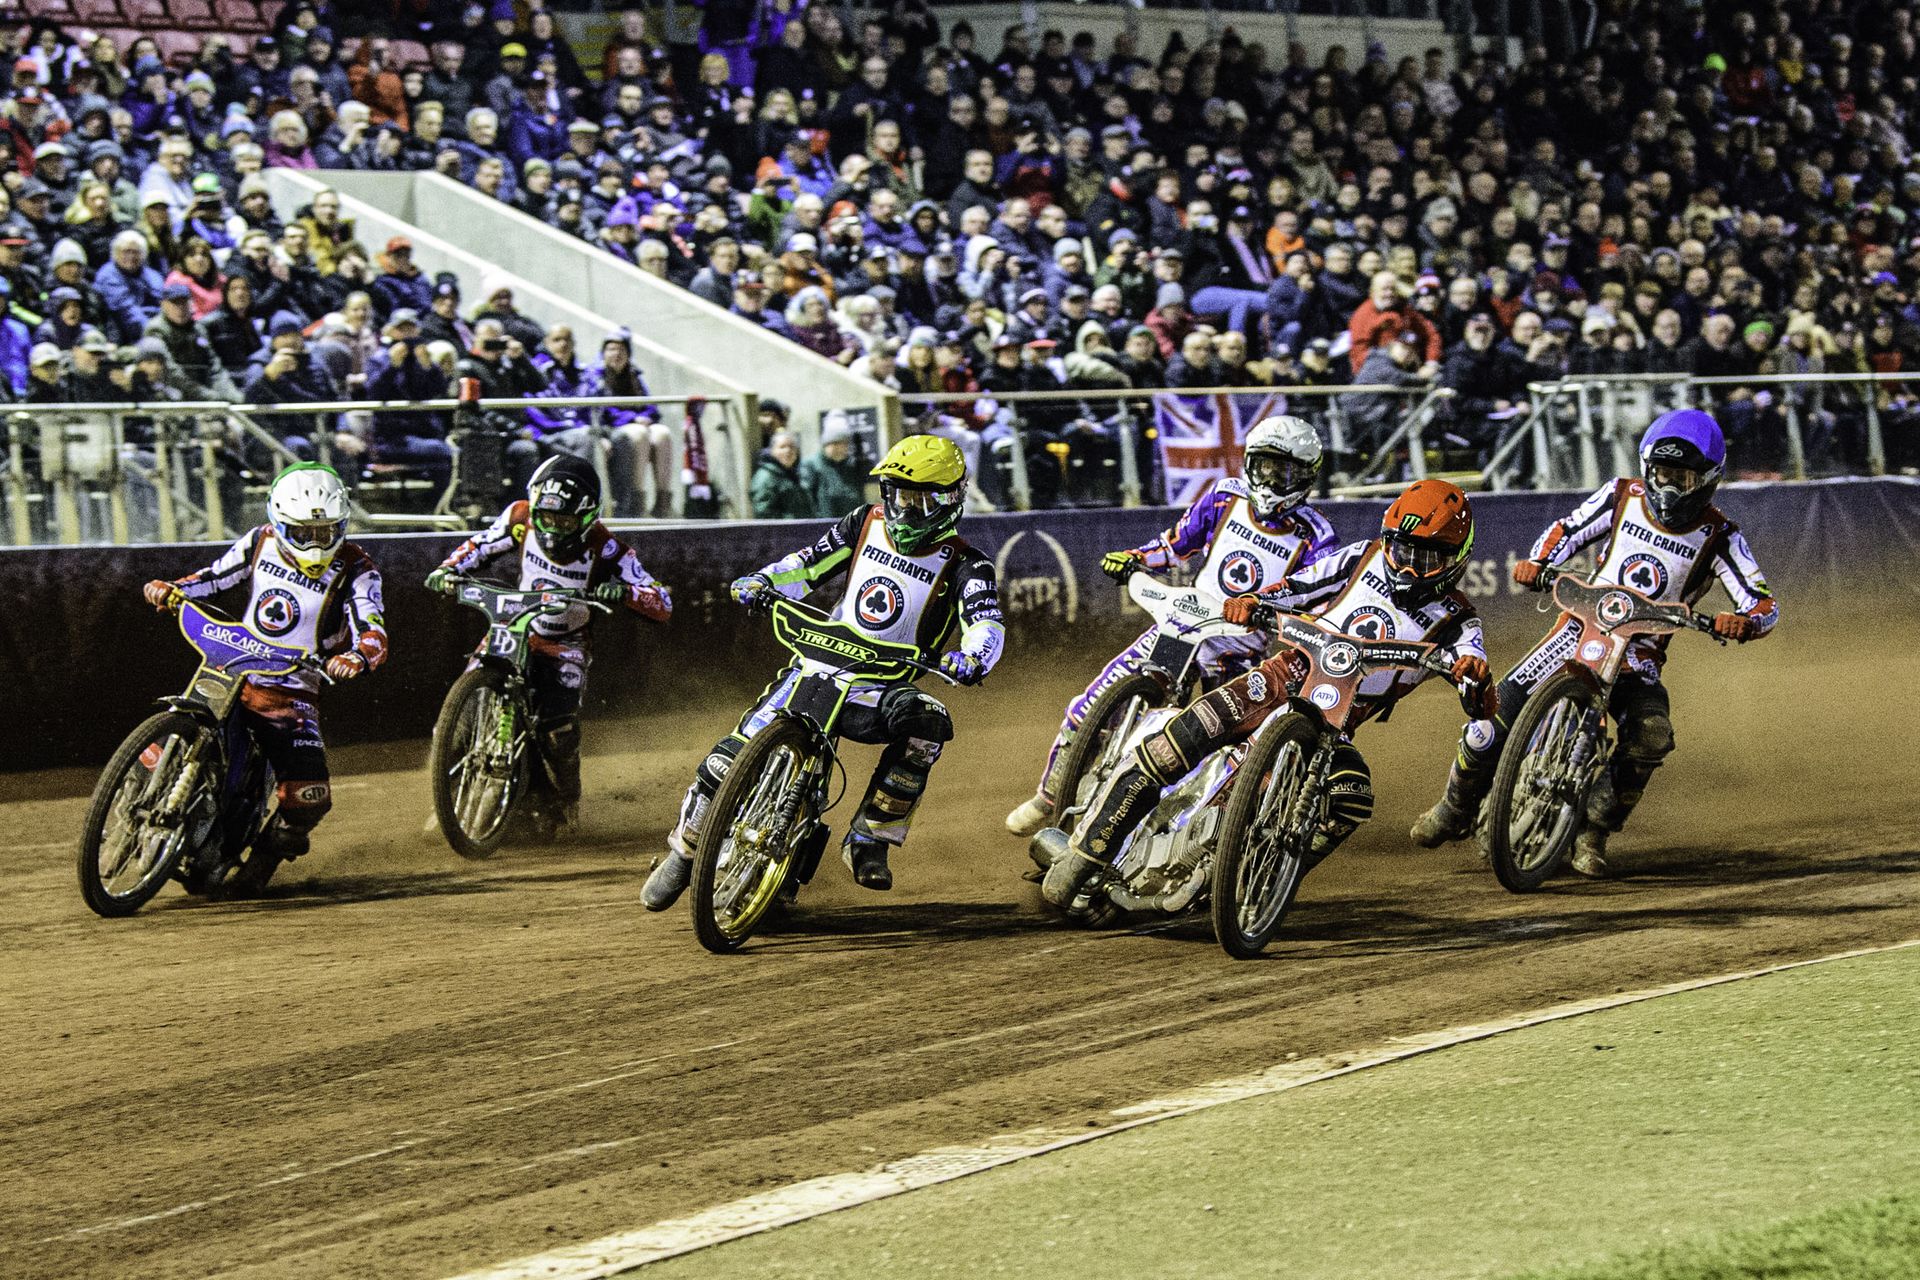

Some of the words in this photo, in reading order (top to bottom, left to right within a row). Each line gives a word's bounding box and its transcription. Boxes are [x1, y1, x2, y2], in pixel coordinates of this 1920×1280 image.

[1227, 520, 1253, 541] PETER
[1252, 533, 1291, 560] CRAVEN
[1621, 520, 1652, 543] PETER
[1653, 535, 1697, 560] CRAVEN
[1700, 524, 1714, 538] 4
[526, 550, 549, 570] PETER
[550, 565, 588, 580] CRAVEN
[862, 545, 892, 566] PETER
[891, 556, 936, 585] CRAVEN
[939, 544, 954, 560] 9
[257, 560, 288, 579] PETER
[287, 571, 328, 595] CRAVEN
[860, 577, 880, 592] BELLE
[881, 578, 893, 588] VUE
[893, 589, 903, 607] ACES
[1173, 599, 1210, 617] Crendon
[1352, 608, 1375, 617] BELLE
[1377, 609, 1391, 623] VUE
[1387, 624, 1395, 639] ACE
[202, 623, 276, 658] GARCAREK
[803, 632, 834, 647] TRU
[834, 642, 871, 660] MIX
[1217, 687, 1241, 720] utomax
[1316, 691, 1334, 701] ATPI
